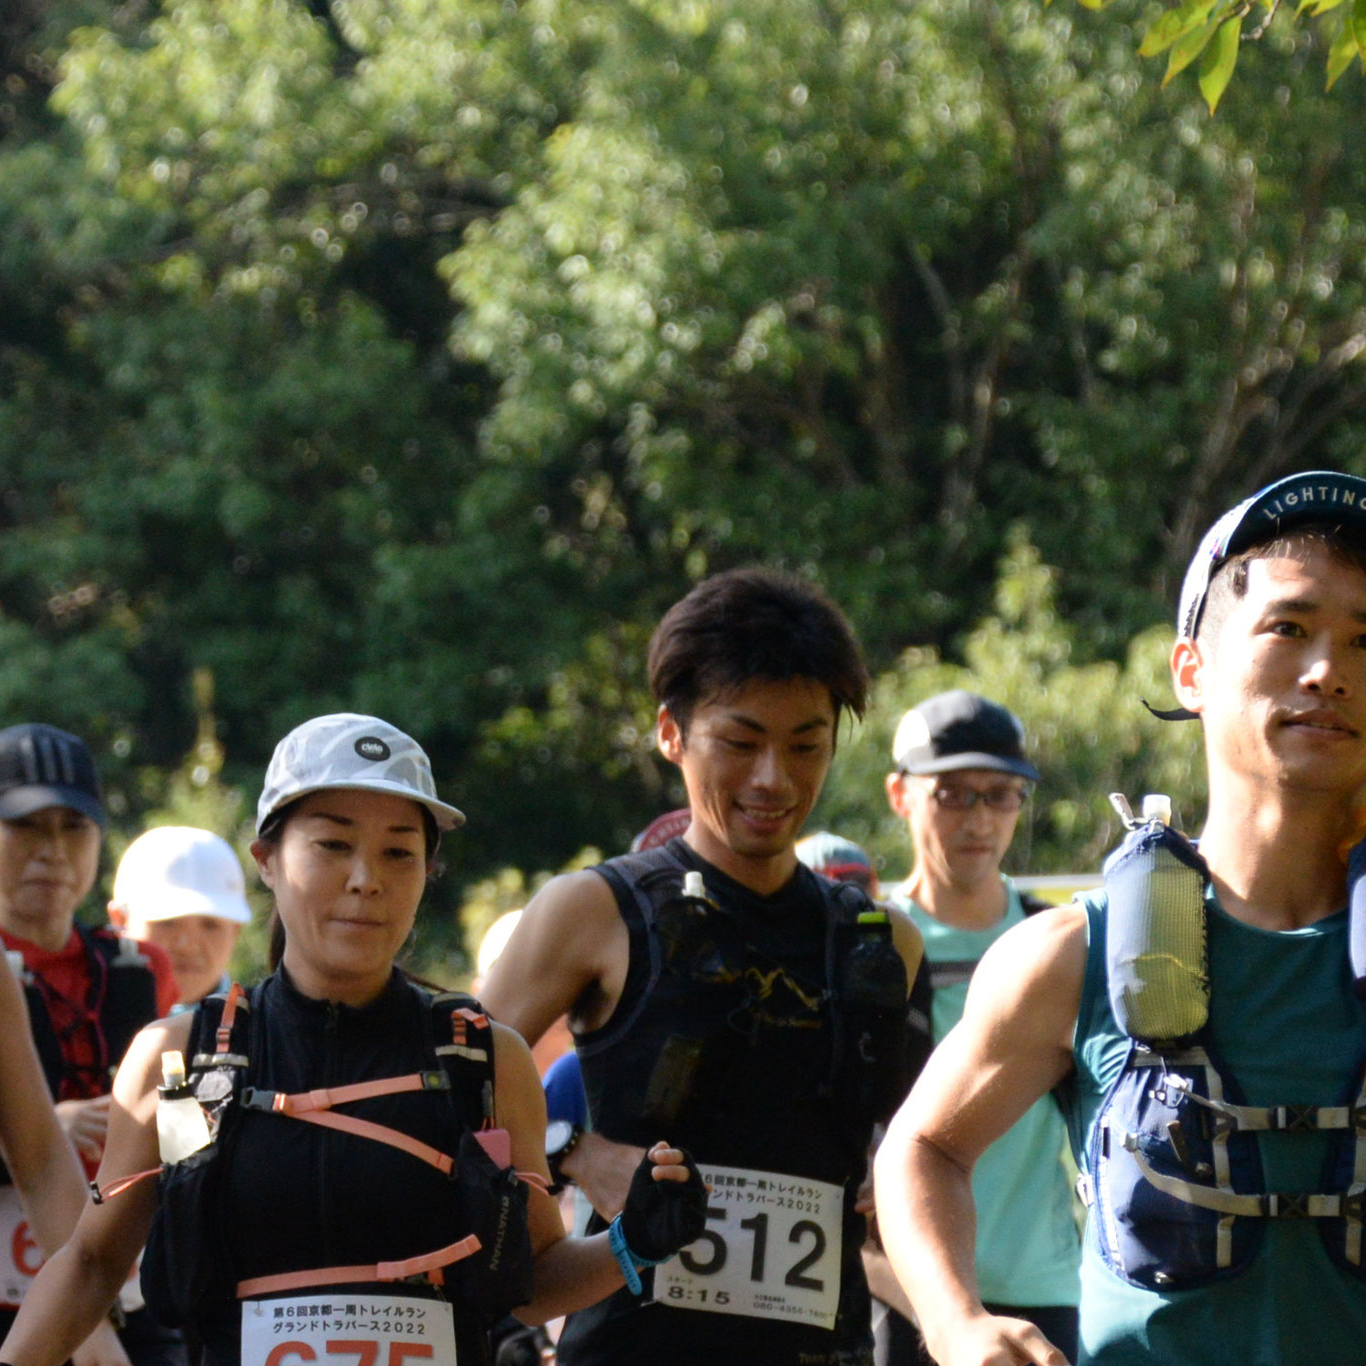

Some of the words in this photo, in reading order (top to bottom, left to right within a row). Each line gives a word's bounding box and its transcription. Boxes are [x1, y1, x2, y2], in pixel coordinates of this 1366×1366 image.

[702, 1173, 823, 1199] 6回京都一周トレイルラン
[679, 1207, 827, 1292] 512
[668, 1286, 731, 1305] 8:15
[273, 1304, 427, 1319] 第6回京都一周トレイルラン
[273, 1320, 426, 1336] グランドトラバース2022
